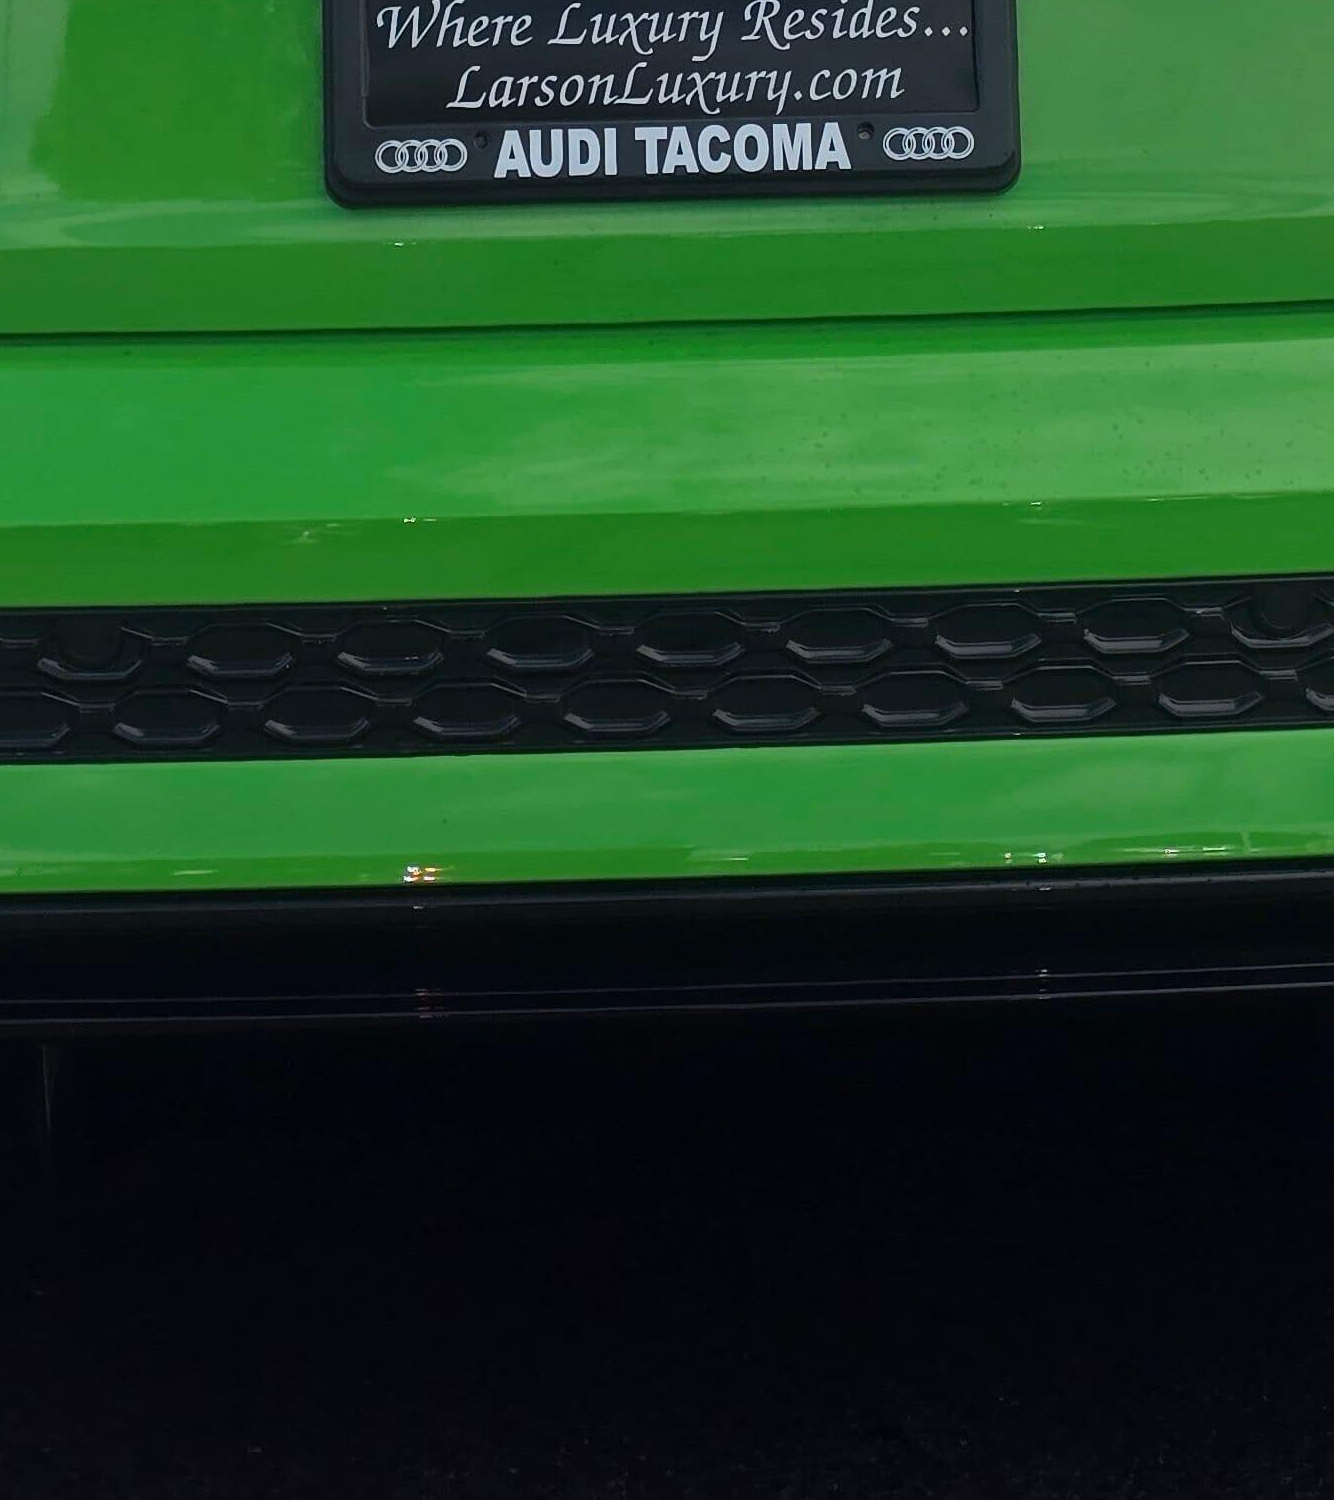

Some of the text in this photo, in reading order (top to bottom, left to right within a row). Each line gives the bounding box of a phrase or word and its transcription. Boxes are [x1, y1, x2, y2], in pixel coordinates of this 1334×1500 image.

[547, 2, 724, 62] Luxury
[445, 61, 905, 116] LarsonLuxury.com
[493, 122, 852, 178] AUDI TACOMA
